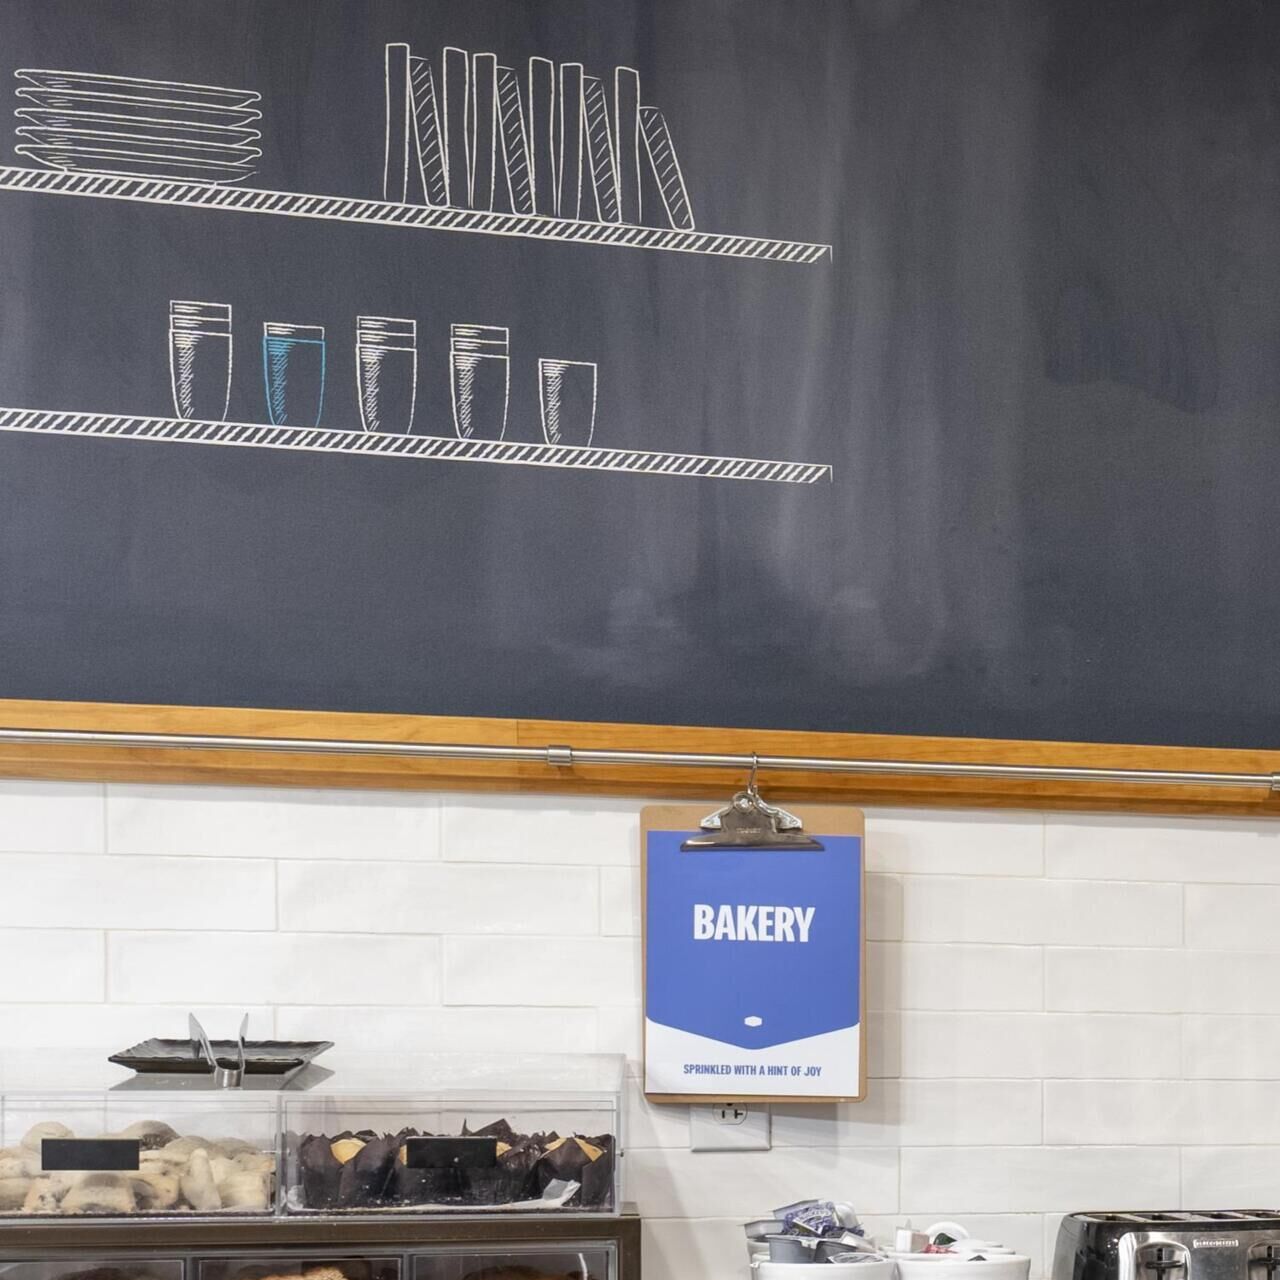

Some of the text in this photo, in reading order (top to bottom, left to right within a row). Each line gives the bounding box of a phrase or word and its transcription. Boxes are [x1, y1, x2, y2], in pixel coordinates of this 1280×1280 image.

[693, 903, 816, 943] BAKERY
[683, 1064, 822, 1077] SPRINKLED WITH A HINT OF JOY
